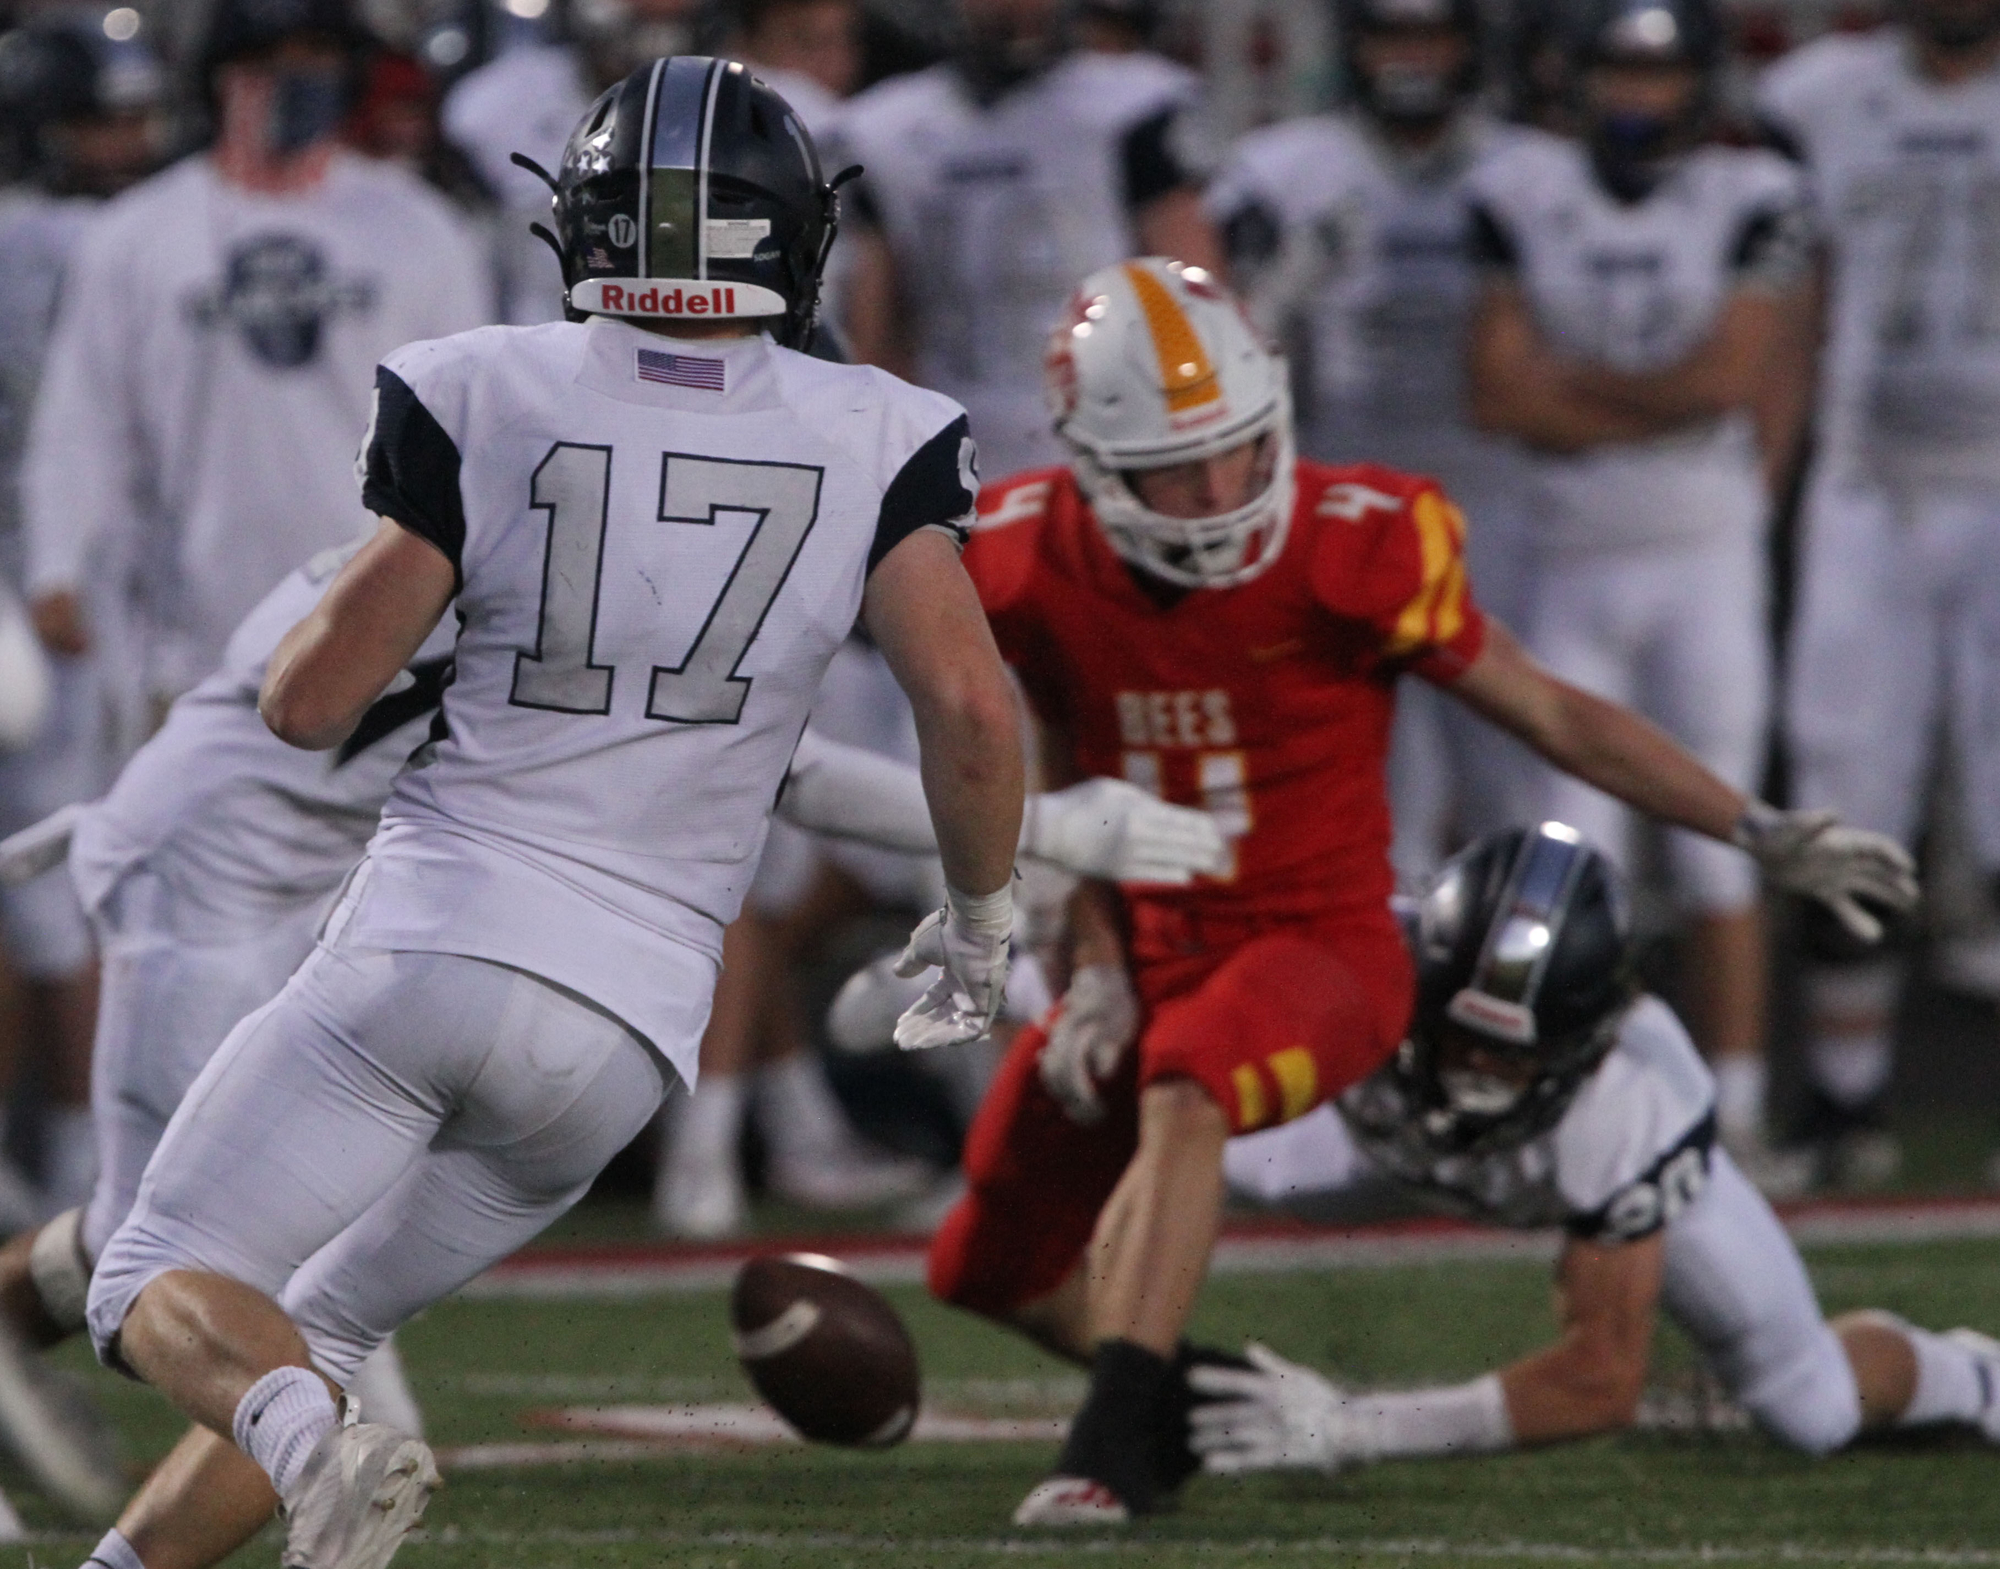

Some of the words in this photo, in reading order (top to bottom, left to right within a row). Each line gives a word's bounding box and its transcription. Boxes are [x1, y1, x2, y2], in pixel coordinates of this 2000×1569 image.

[614, 218, 631, 244] 17
[601, 284, 735, 314] Riddell
[508, 441, 825, 724] 17
